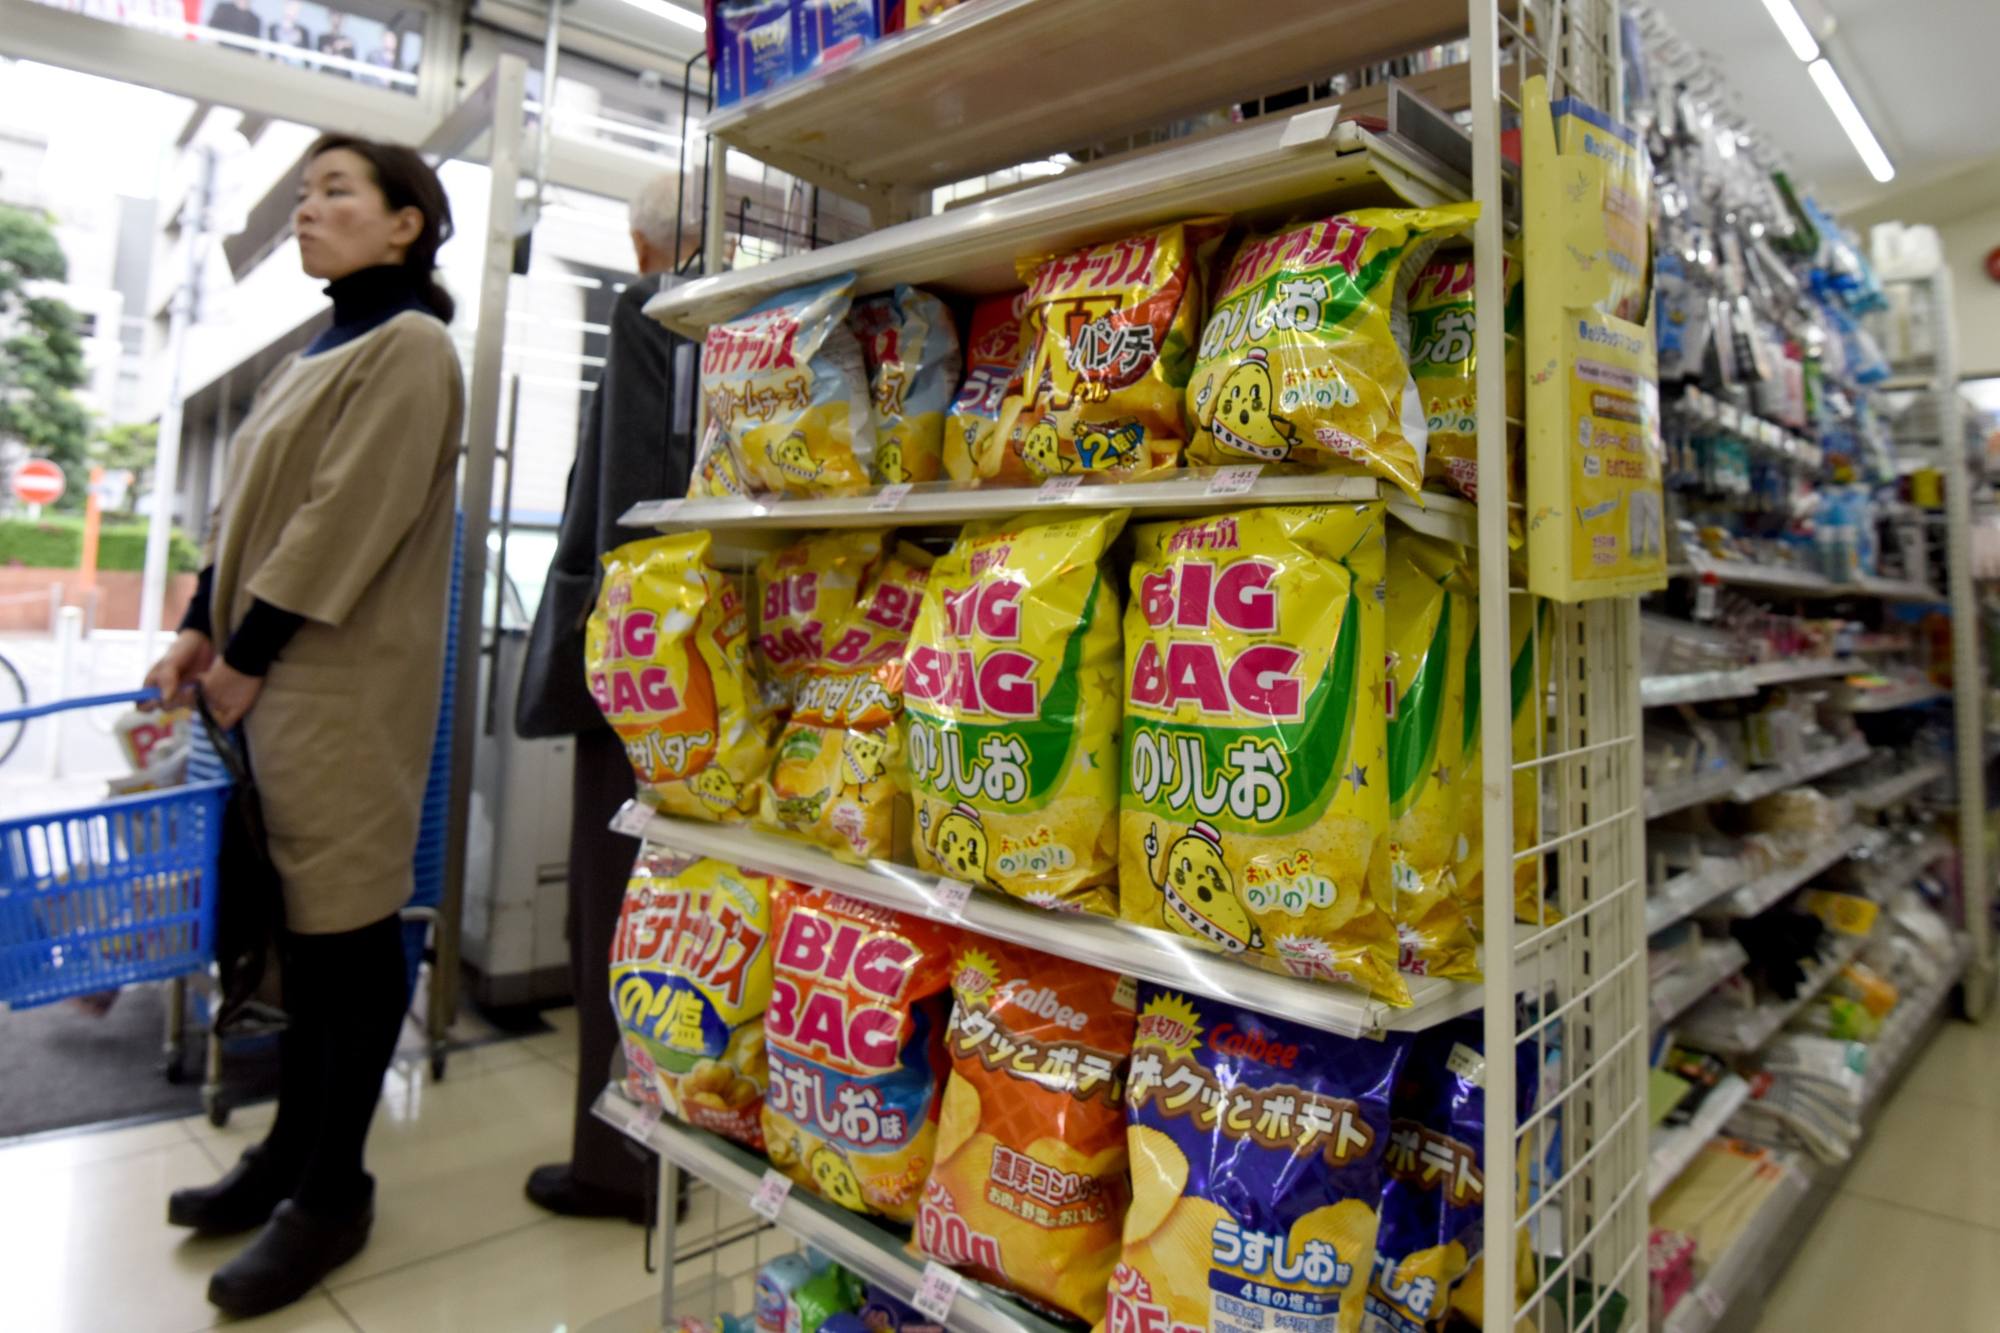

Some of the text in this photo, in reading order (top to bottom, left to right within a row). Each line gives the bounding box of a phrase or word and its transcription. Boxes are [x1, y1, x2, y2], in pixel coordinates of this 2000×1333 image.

[1069, 318, 1153, 373] パンチ
[1199, 279, 1328, 360] のりしお
[1141, 561, 1279, 631] BIG
[904, 649, 1037, 717] BAG
[1130, 642, 1302, 716] BAG
[909, 723, 1027, 803] のりしお
[1132, 732, 1287, 822] のりしお
[1000, 847, 1064, 872] のりのり!
[1247, 853, 1309, 884] おいしさ
[1248, 877, 1326, 909] のりのり!
[779, 909, 914, 998] BIG
[1168, 890, 1237, 949] POTATO
[766, 978, 901, 1068] BAG
[1000, 979, 1089, 1032] Calbee
[1208, 1023, 1298, 1069] Calbee
[768, 1054, 903, 1143] うすしお味
[1130, 1053, 1368, 1158] ザクッとポテト
